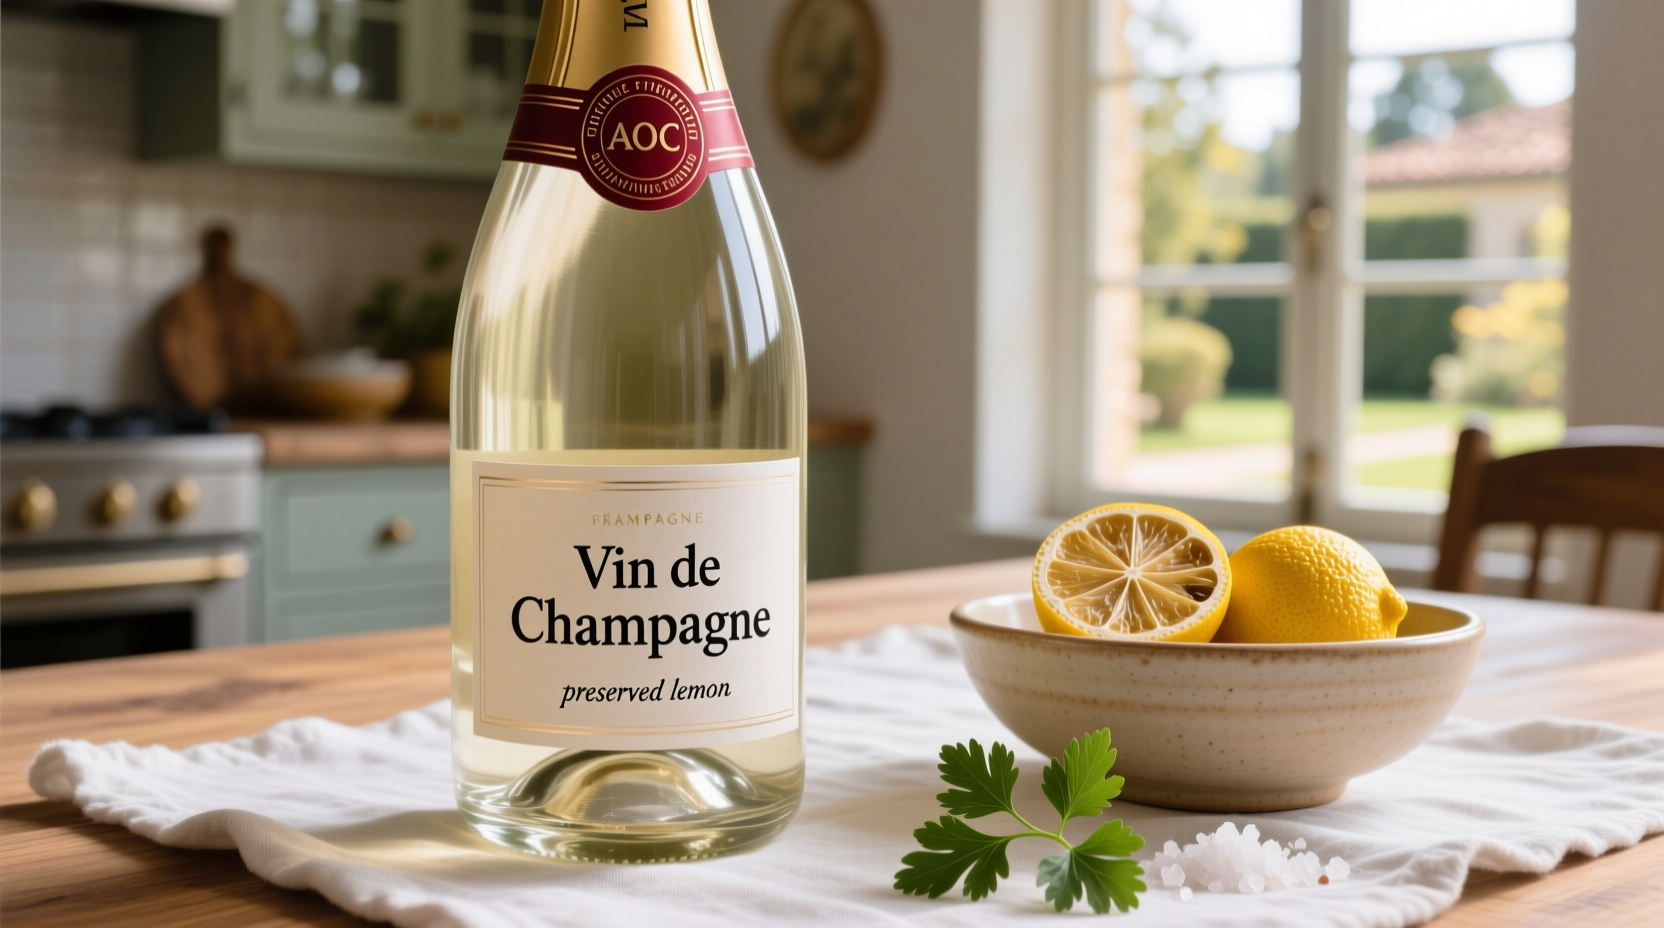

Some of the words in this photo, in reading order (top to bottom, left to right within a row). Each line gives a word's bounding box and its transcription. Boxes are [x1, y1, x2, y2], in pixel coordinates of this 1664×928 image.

[606, 121, 681, 152] AOC
[573, 545, 657, 590] Vin
[670, 543, 721, 588] de
[511, 596, 771, 659] Champagne
[559, 679, 665, 709] preserved
[670, 678, 732, 701] lemon
